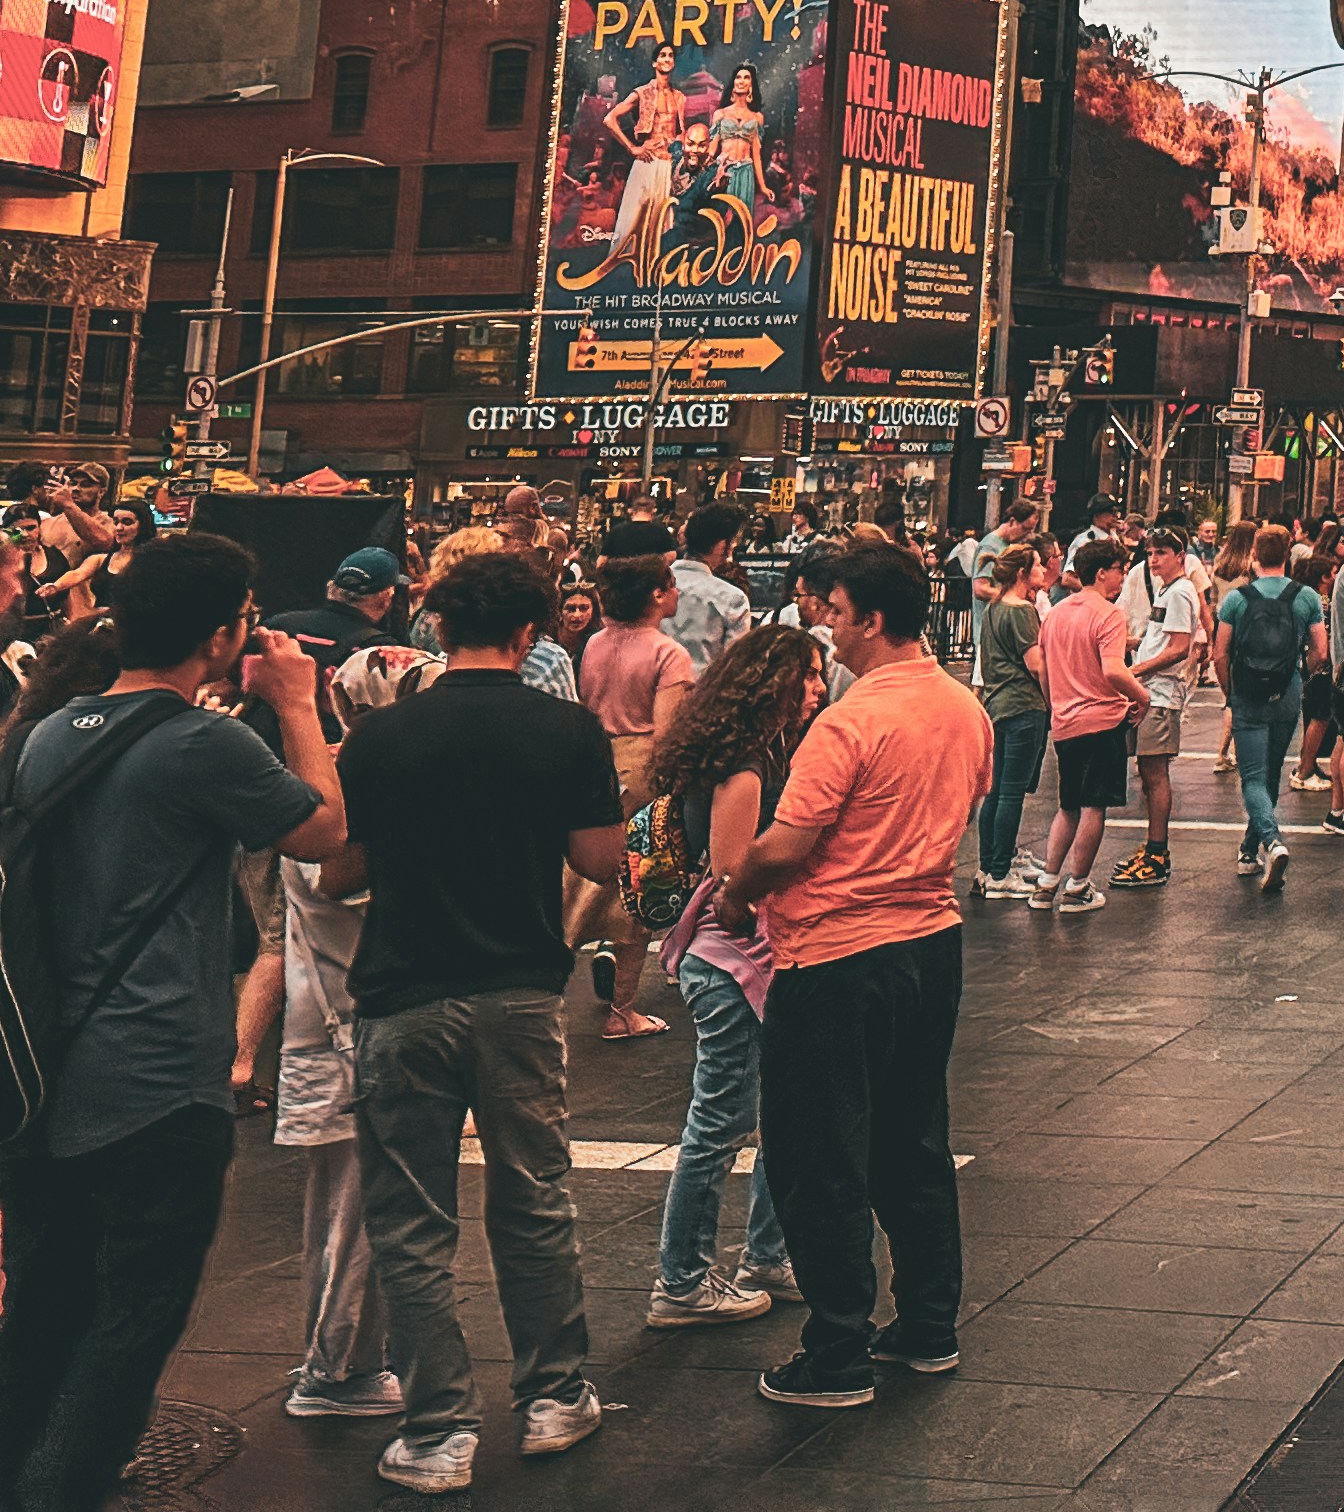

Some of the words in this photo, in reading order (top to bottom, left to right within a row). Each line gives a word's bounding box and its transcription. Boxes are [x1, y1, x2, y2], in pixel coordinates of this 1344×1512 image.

[847, 51, 893, 108] NEIL
[897, 62, 991, 129] DIAMOND
[842, 105, 925, 170] MUSICAL
[834, 164, 852, 242] A
[857, 166, 976, 255] BEAUTIFUL
[556, 193, 802, 290] Aladdin
[828, 241, 903, 324] NOISE
[575, 296, 601, 309] THE
[605, 295, 627, 308] HIT
[631, 292, 714, 307] BROADWAY
[717, 290, 782, 306] MUSICAL
[554, 319, 585, 332] YOUR
[589, 317, 619, 330] WISH
[623, 317, 663, 330] COMES
[668, 316, 697, 328] TRUE
[702, 316, 709, 327] 4
[714, 314, 760, 327] BLOCKS
[764, 314, 799, 325] AWAY
[601, 350, 618, 361] 7th
[467, 405, 557, 431] GIFTS
[580, 402, 730, 431] LUGGAGE
[809, 401, 864, 425] GIFTS
[877, 402, 960, 427] LUGGAGE
[600, 446, 642, 457] SONY
[900, 443, 929, 453] SONY
